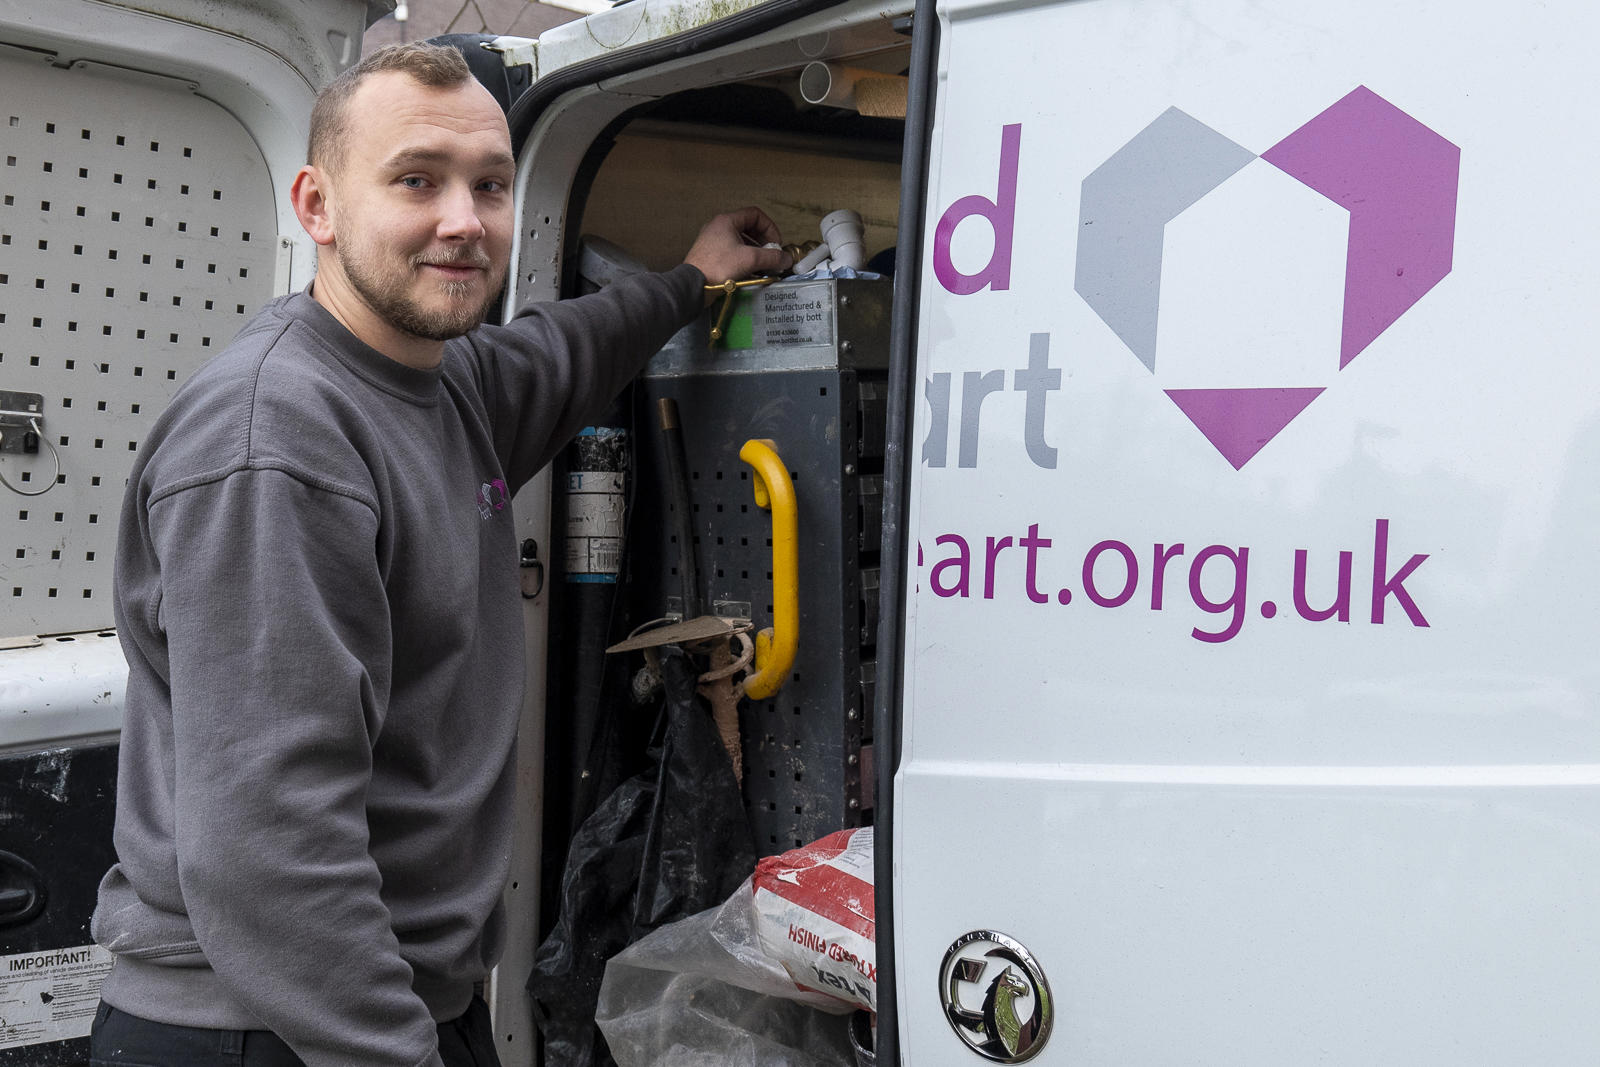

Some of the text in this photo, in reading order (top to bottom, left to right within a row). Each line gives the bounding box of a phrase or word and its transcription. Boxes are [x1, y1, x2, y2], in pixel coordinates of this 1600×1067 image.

[933, 123, 1022, 296] d
[764, 291, 798, 302] Designed,
[765, 301, 822, 312] Manufactured &
[765, 313, 822, 324] Installed by bott
[916, 518, 1431, 644] art.org.uk
[788, 923, 827, 955] FINISH
[9, 951, 91, 971] IMPORTANT!
